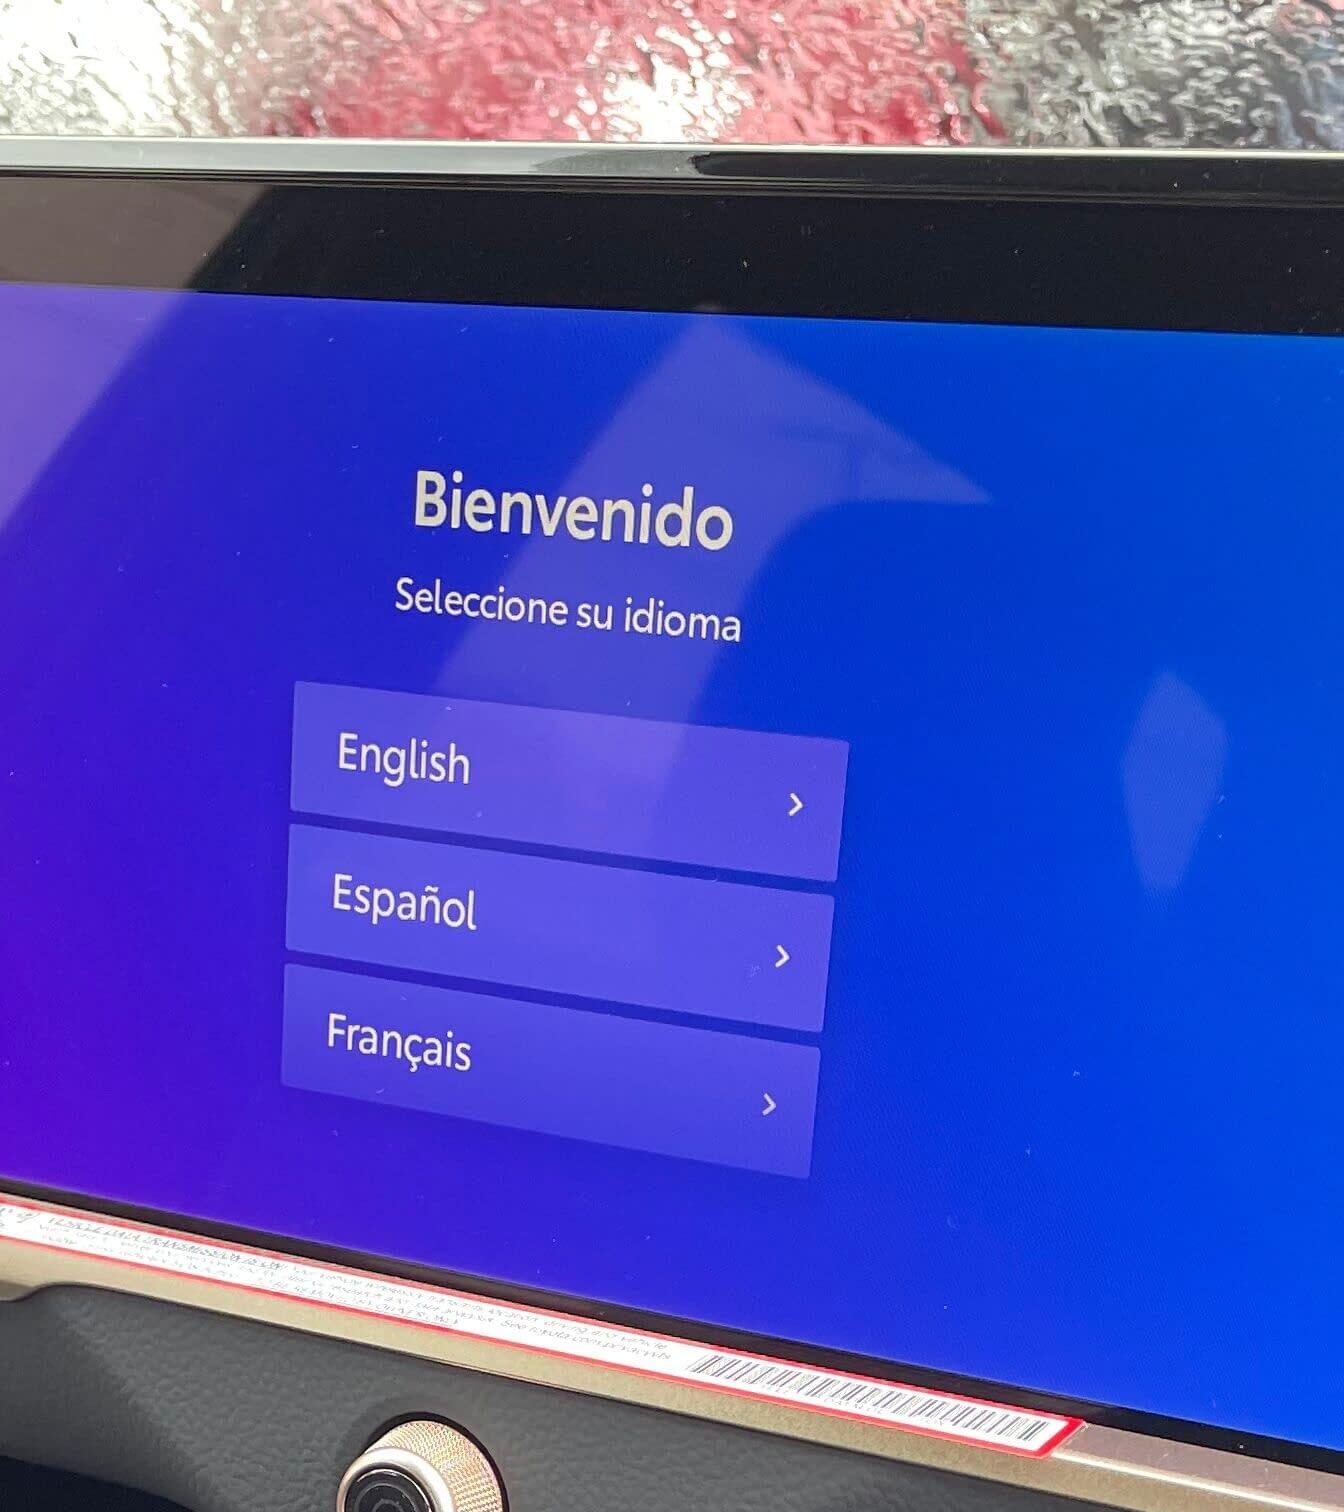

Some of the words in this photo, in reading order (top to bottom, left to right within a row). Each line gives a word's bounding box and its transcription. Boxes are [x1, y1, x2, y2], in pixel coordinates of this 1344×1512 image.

[414, 469, 735, 551] Bienvenido
[395, 576, 569, 628] Seleccione
[576, 601, 613, 631] su
[624, 596, 742, 643] idioma
[337, 732, 471, 788] English
[332, 872, 478, 932] Español
[326, 1012, 472, 1072] Français
